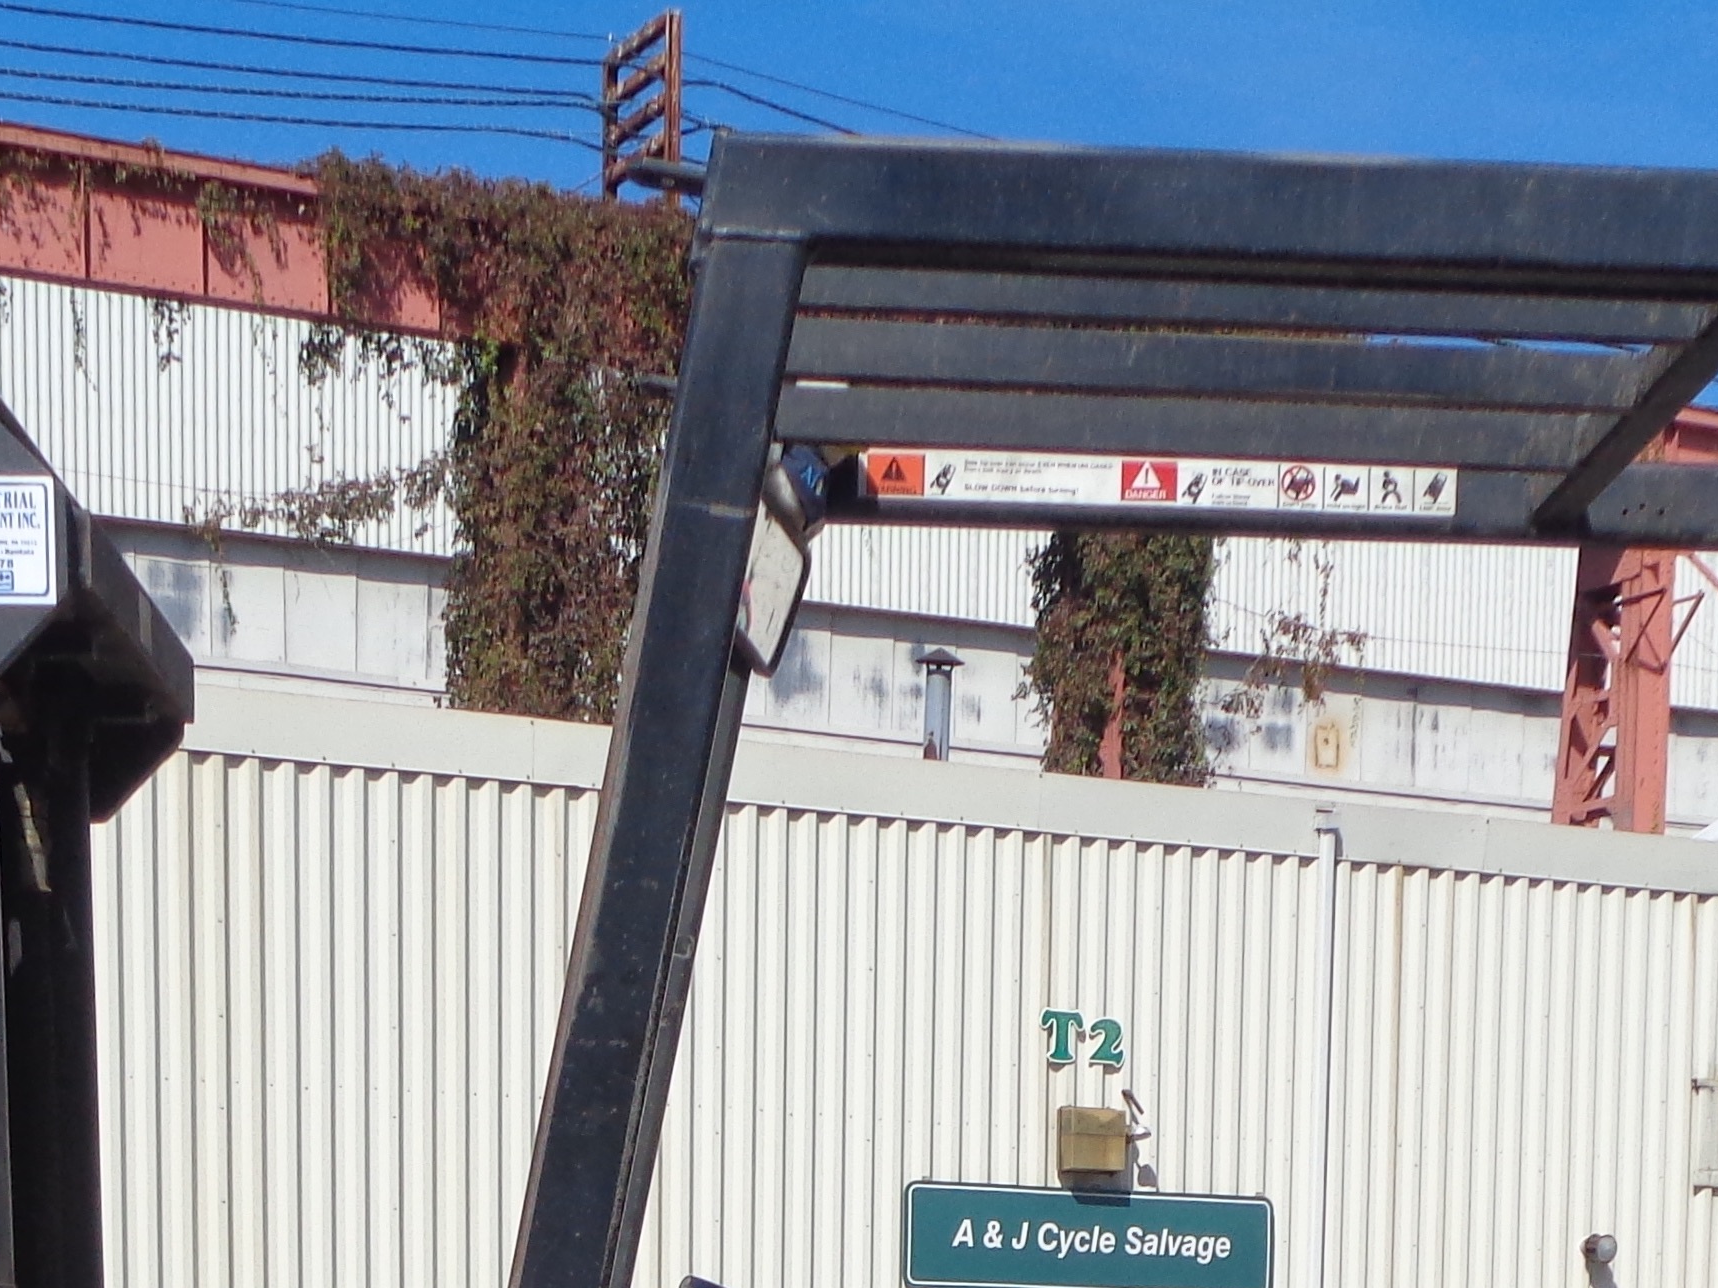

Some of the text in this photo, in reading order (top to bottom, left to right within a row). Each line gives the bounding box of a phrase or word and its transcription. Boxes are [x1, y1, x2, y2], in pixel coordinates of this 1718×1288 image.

[1125, 489, 1167, 499] DANGER
[18, 512, 41, 529] INC.
[1041, 1007, 1126, 1067] T2
[952, 1219, 1232, 1264] A & J Cycle Salvage
